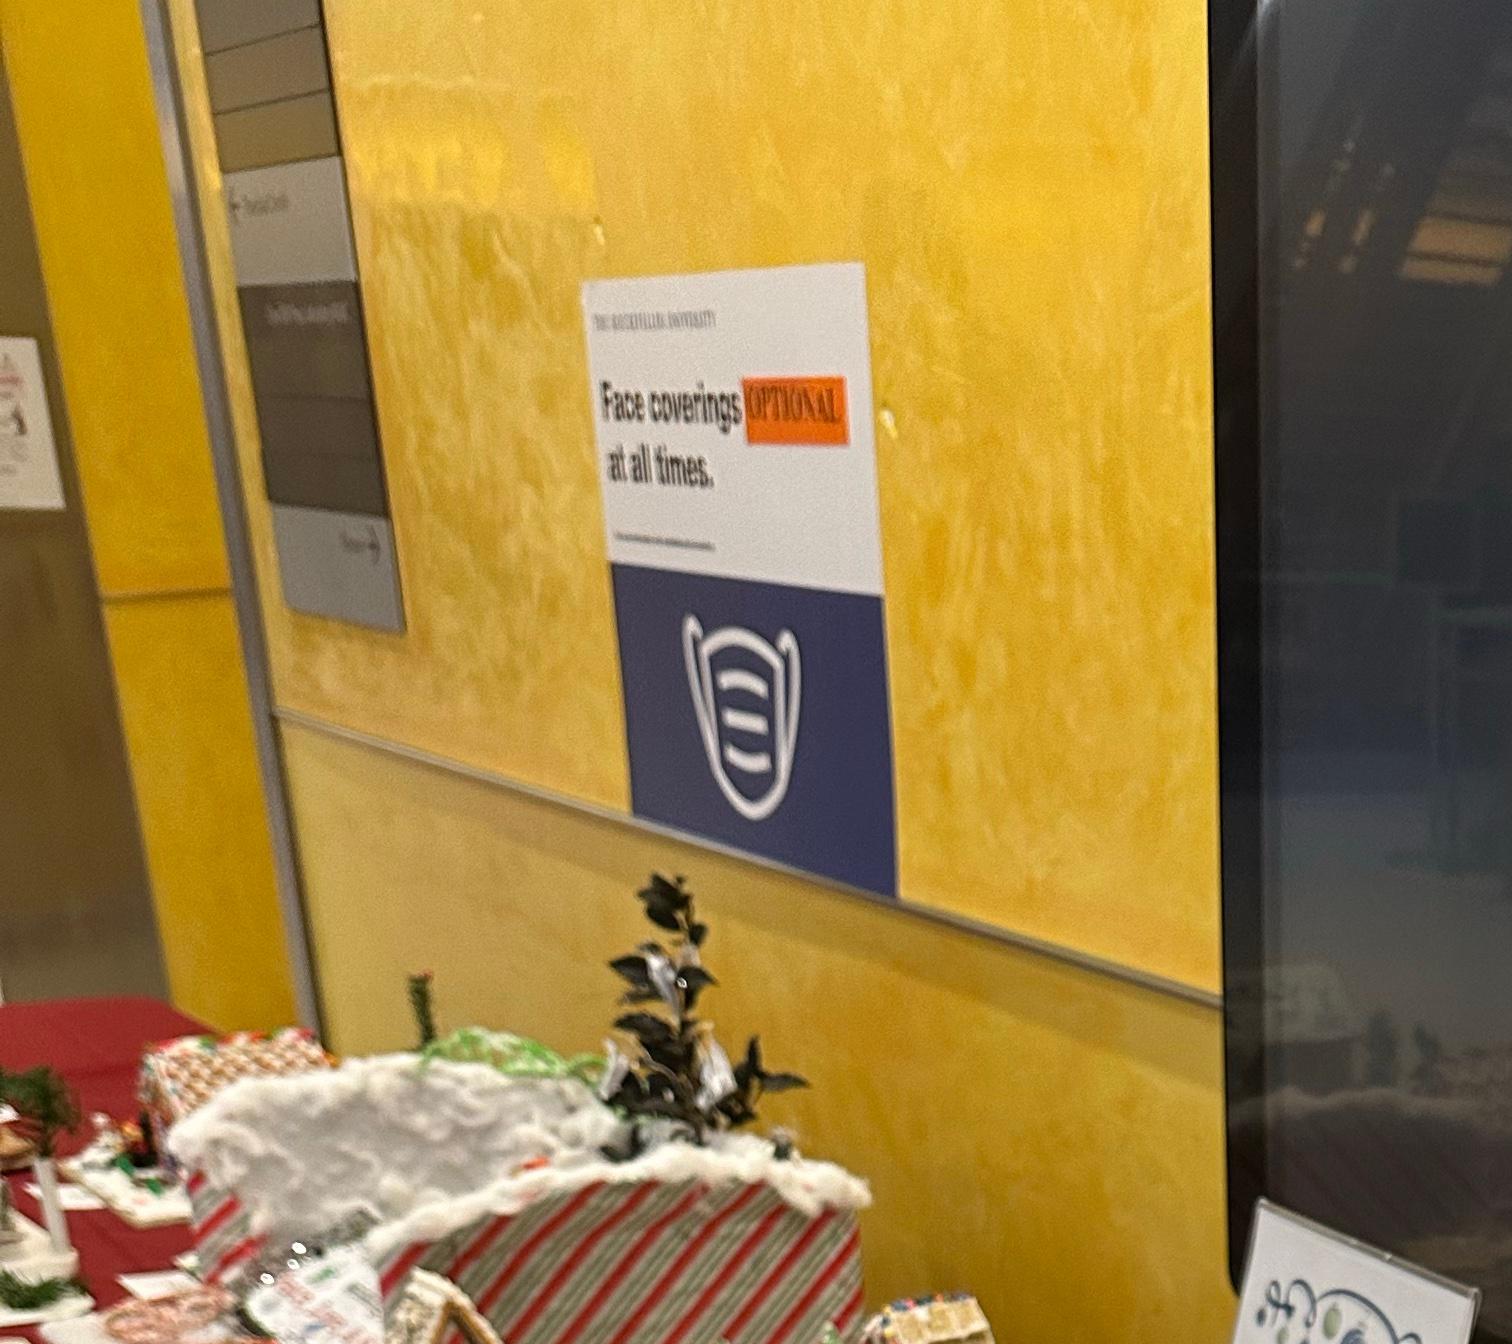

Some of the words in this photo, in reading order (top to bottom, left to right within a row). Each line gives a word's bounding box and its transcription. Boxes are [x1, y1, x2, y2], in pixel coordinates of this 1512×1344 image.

[600, 380, 646, 422] Face
[650, 381, 743, 434] coverings
[749, 383, 839, 423] OPTIONAL
[608, 444, 628, 483] at
[631, 443, 653, 484] all
[654, 443, 715, 489] times.
